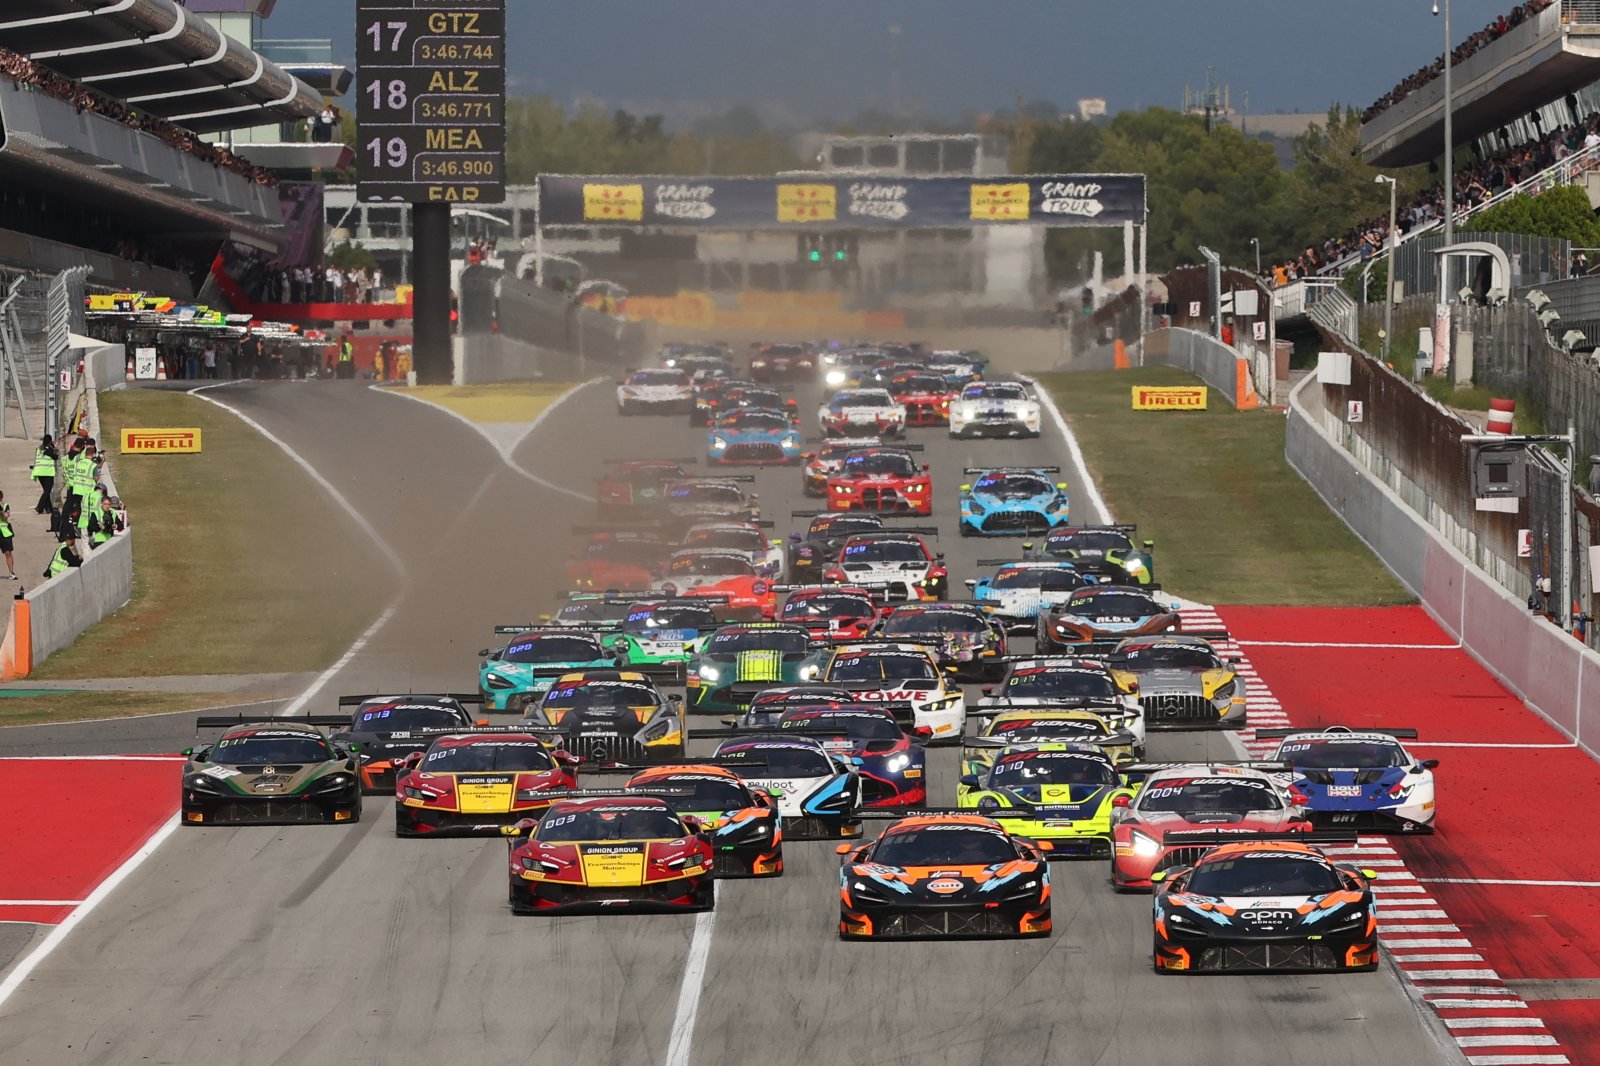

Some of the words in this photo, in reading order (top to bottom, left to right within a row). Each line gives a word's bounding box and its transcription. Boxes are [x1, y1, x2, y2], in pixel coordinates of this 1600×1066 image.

[428, 12, 480, 34] GTZ
[366, 21, 408, 52] 17
[421, 45, 494, 60] 3:46.744
[428, 71, 480, 92] ALZ
[366, 79, 408, 110] 18
[422, 103, 492, 118] 3:46.771
[425, 129, 483, 150] MEA
[366, 137, 408, 168] 19
[422, 161, 494, 175] 3:46.900
[1041, 182, 1102, 198] GRAND
[1049, 200, 1094, 213] TOUR
[1139, 391, 1201, 406] PIRELLI
[127, 433, 194, 449] PIRELLI
[1031, 720, 1097, 730] WORLD
[1296, 732, 1387, 741] KRAMSKI
[1036, 752, 1106, 763] WORLD
[1191, 778, 1265, 789] WORLD
[1151, 786, 1183, 799] 004
[545, 814, 577, 829] 003
[925, 825, 1004, 836] WORLD
[1243, 852, 1327, 863] WORLD
[1240, 910, 1293, 925] apm
